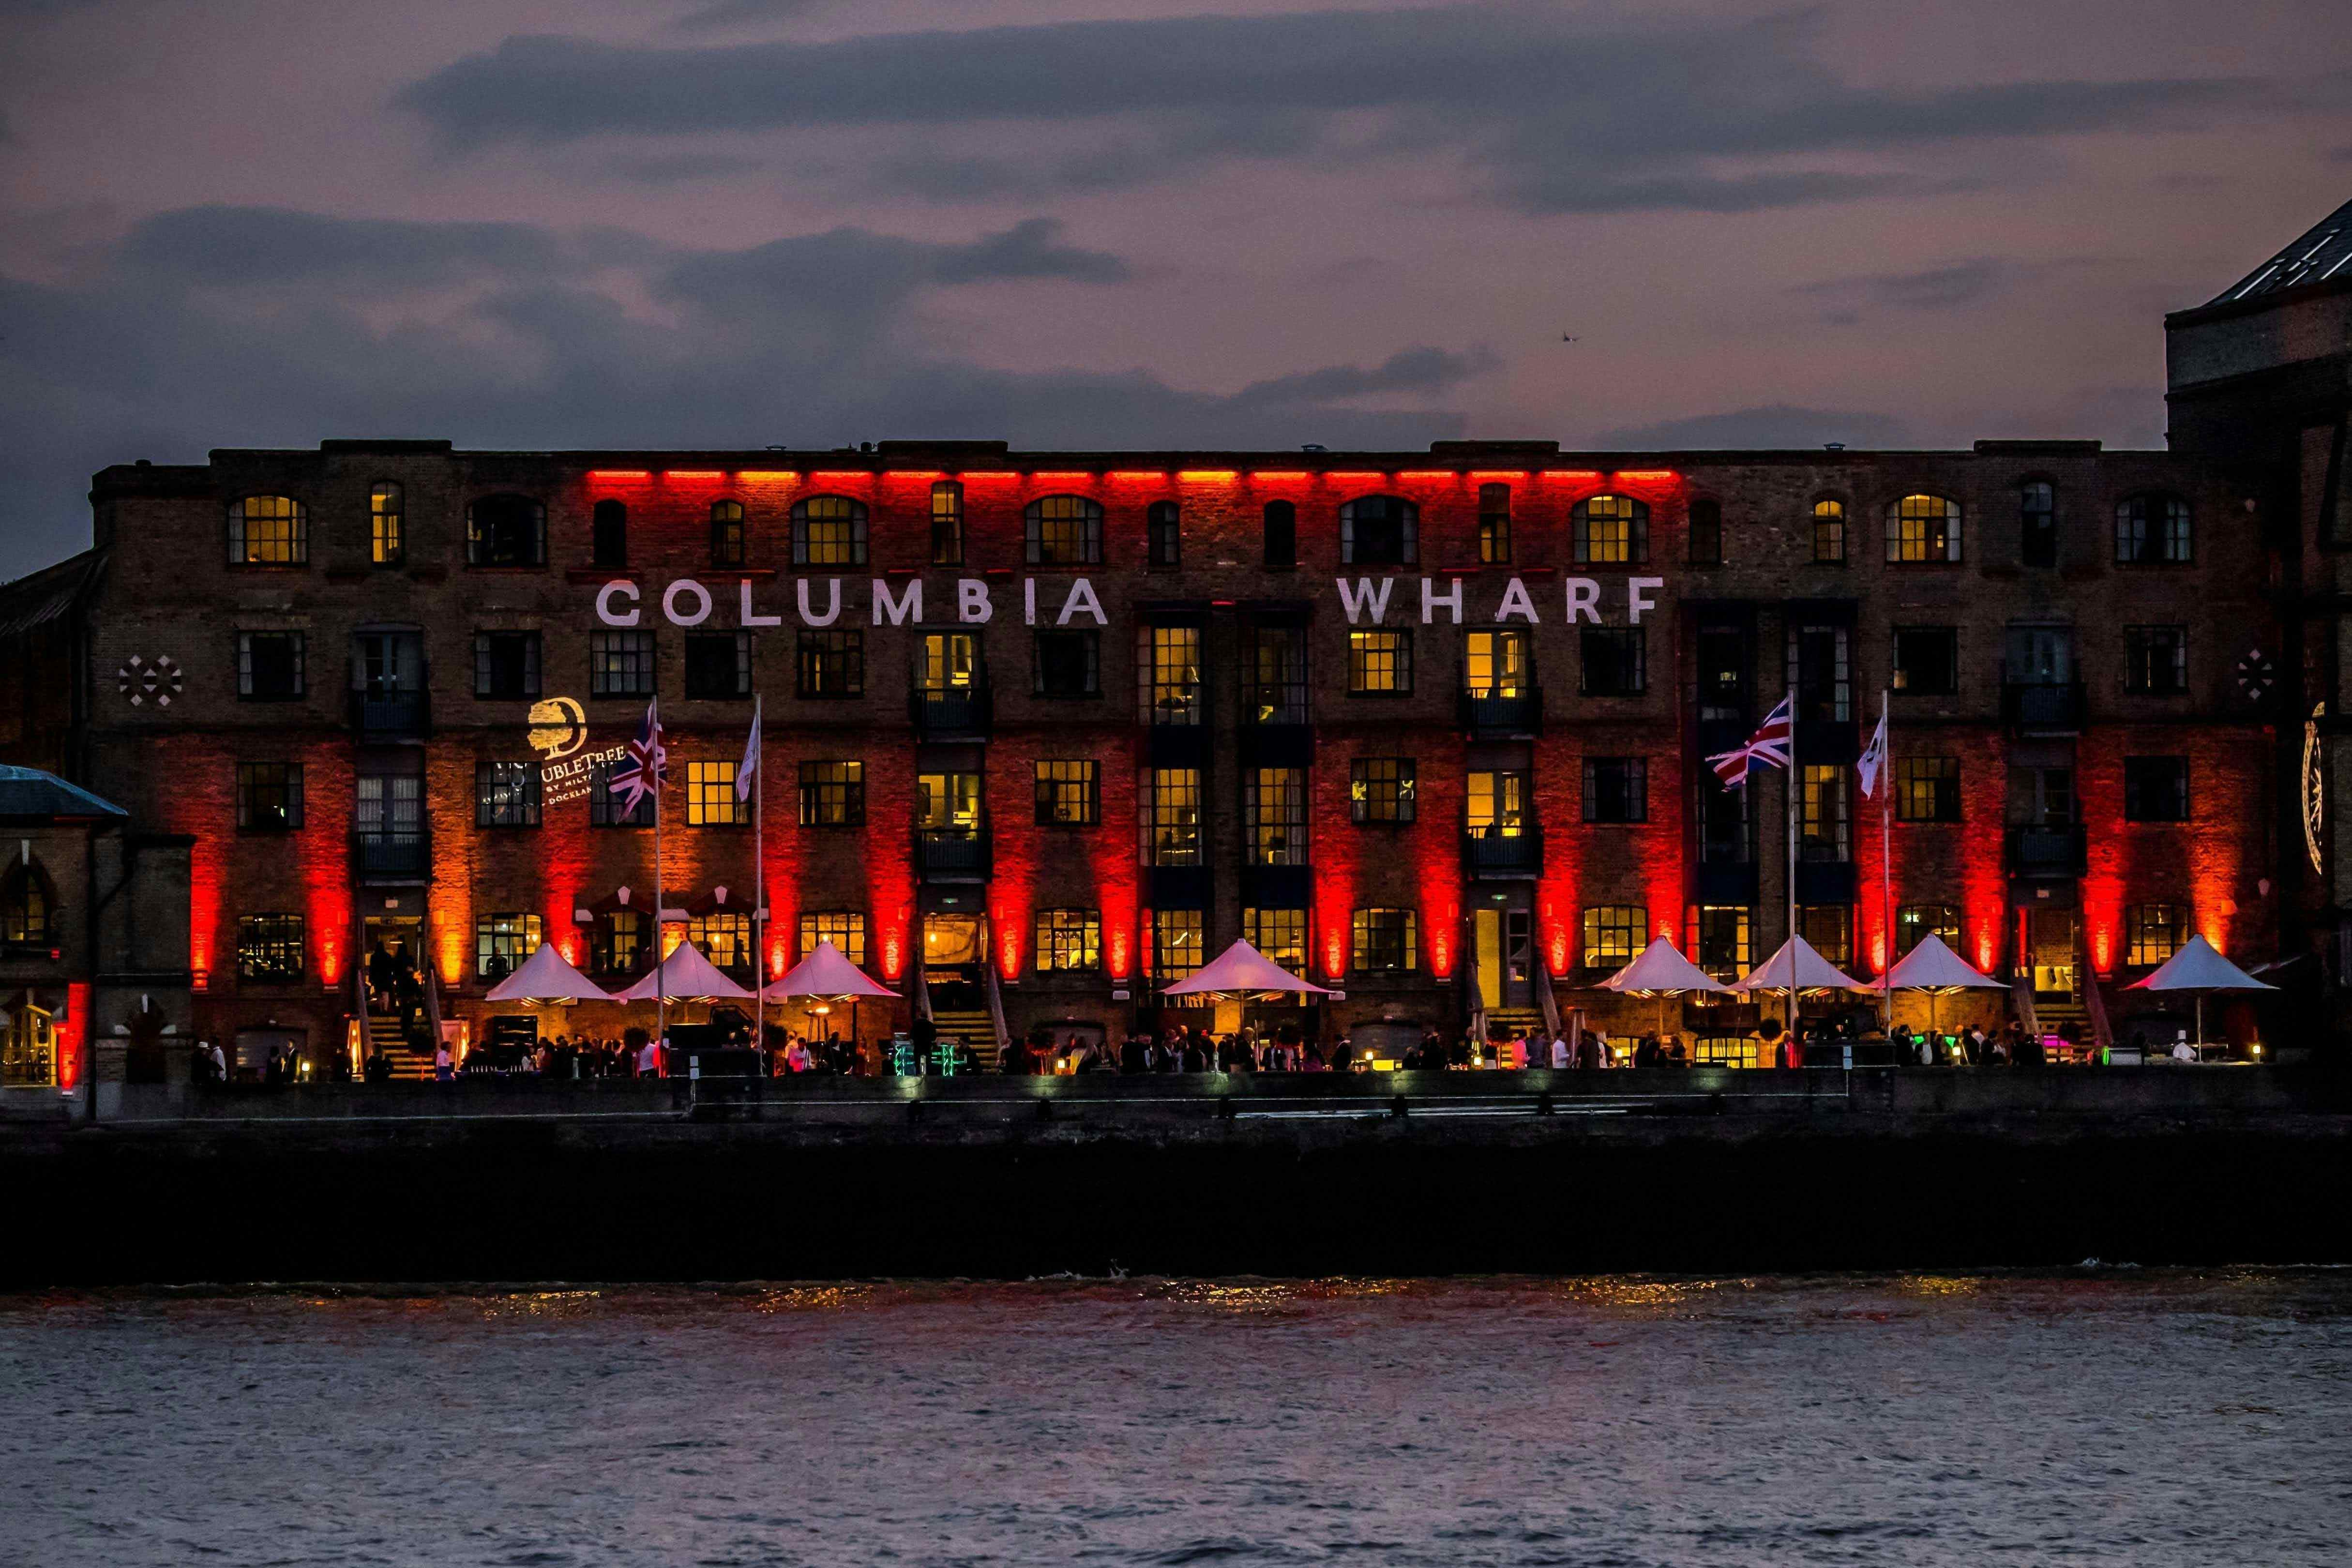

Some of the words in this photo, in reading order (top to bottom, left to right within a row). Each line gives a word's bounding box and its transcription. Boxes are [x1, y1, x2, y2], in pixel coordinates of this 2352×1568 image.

[595, 578, 1108, 627] COLUMBIA
[1336, 577, 1664, 624] WHARF
[497, 746, 626, 783] UBLETREE
[549, 786, 592, 805] DOCKLAN
